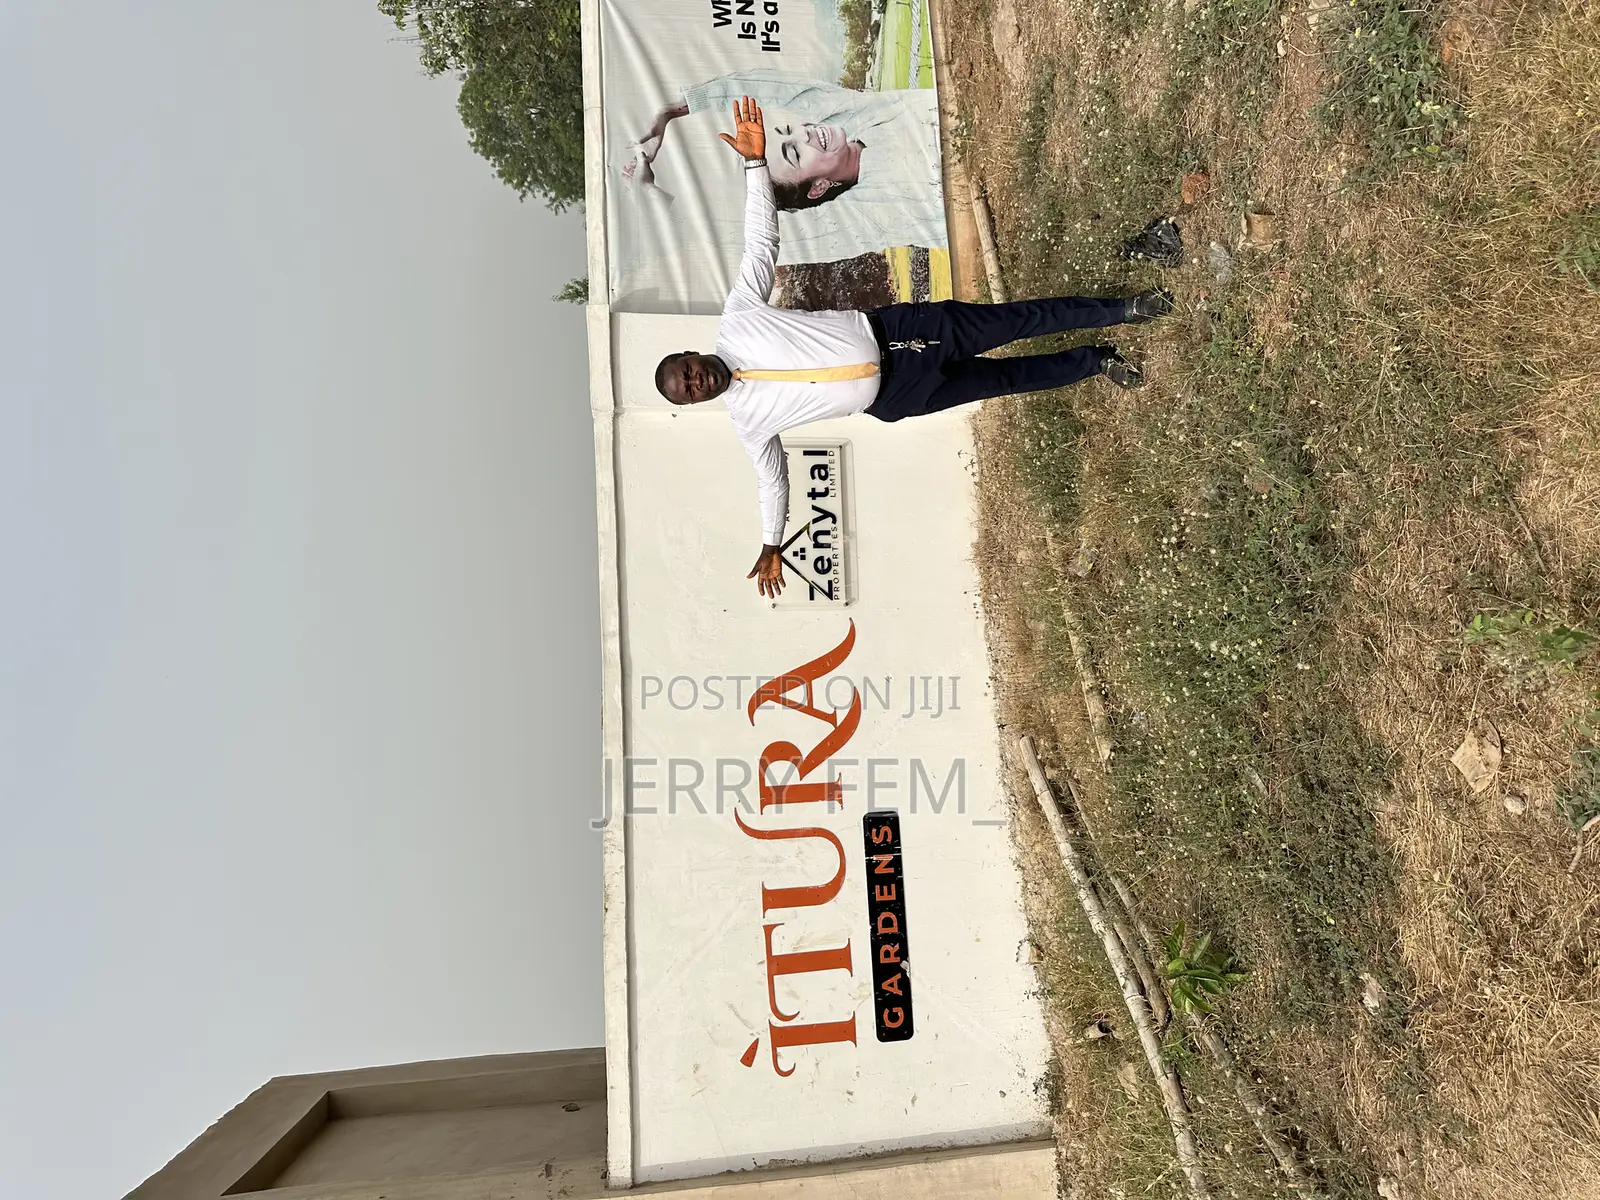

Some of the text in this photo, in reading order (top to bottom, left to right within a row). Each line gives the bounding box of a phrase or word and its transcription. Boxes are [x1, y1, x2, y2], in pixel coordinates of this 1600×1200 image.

[737, 21, 757, 40] Is
[761, 1, 781, 52] It's a
[828, 450, 837, 498] LIMITED
[802, 450, 837, 601] Zenytal
[871, 825, 905, 1029] GARDENS
